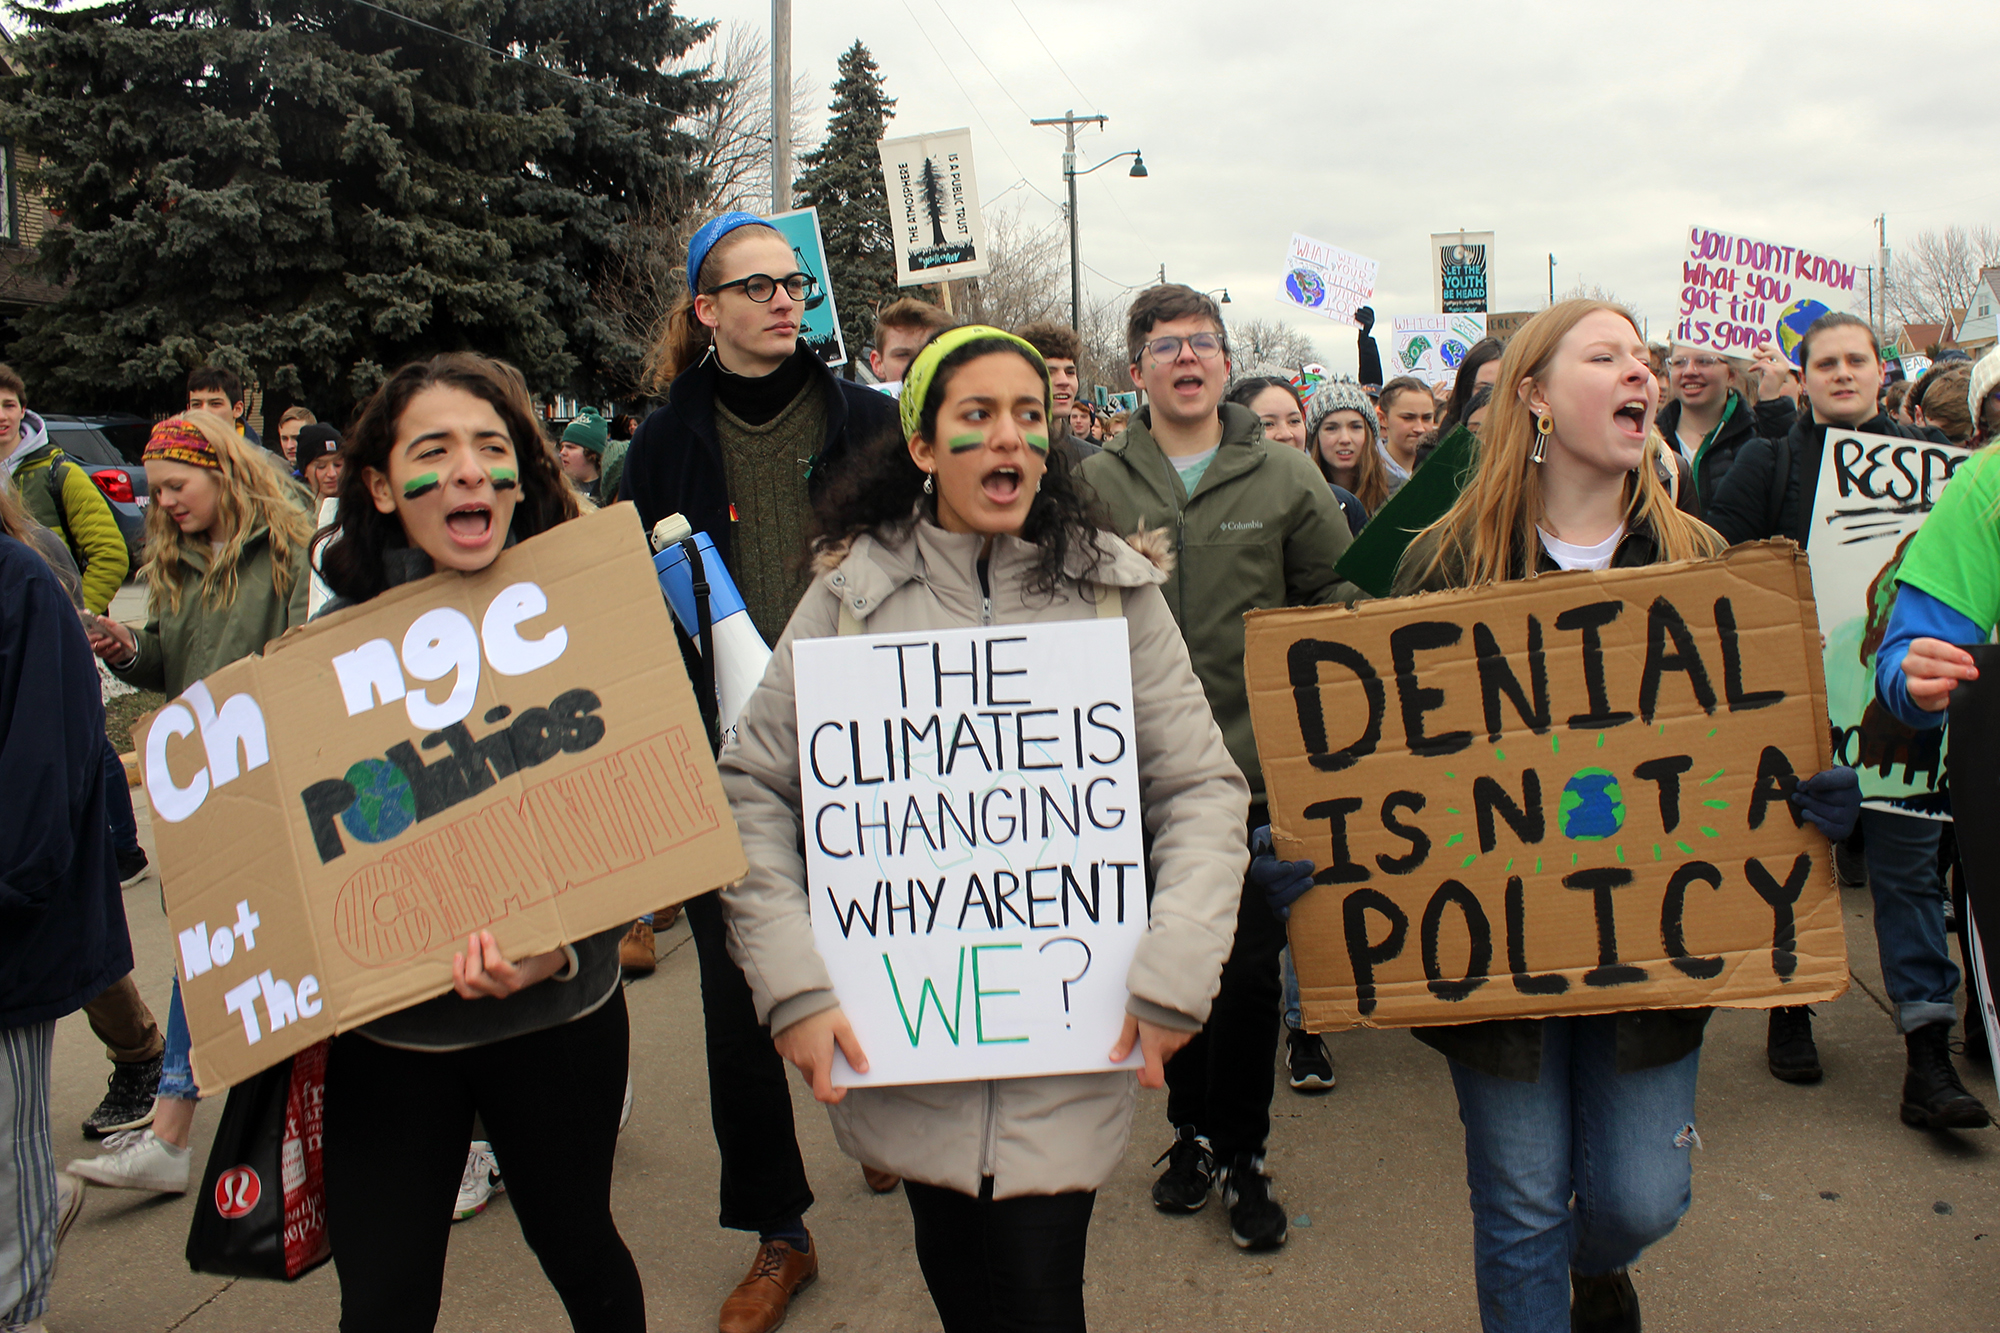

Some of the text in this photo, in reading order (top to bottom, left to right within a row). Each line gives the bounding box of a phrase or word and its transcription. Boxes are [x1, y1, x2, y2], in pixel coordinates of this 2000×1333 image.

[948, 153, 958, 162] IS
[898, 162, 919, 243] THE ATMOSPHERE
[951, 172, 964, 205] PUBLIC
[955, 207, 968, 235] TRUST
[1297, 239, 1335, 266] WHAT
[1690, 228, 1733, 262] YOU
[1443, 275, 1484, 289] YOUTH
[1447, 265, 1480, 275] LET THE
[1326, 298, 1358, 318] LOO
[1443, 288, 1485, 299] BE HEARD
[1680, 286, 1765, 325] got till
[1394, 316, 1446, 331] WHICH
[1711, 321, 1772, 351] gone
[1227, 520, 1263, 531] Columbia
[872, 636, 1031, 709] THE
[1286, 594, 1787, 772] DENIAL
[809, 701, 1126, 789] CLIMATE IS
[815, 776, 1126, 859] CHANGING
[1303, 789, 1433, 886] IS
[1747, 745, 1805, 831] A
[826, 858, 1139, 940] WHY AREN'T
[178, 898, 260, 982] Not
[1342, 852, 1812, 1017] POLICY
[224, 968, 323, 1046] The
